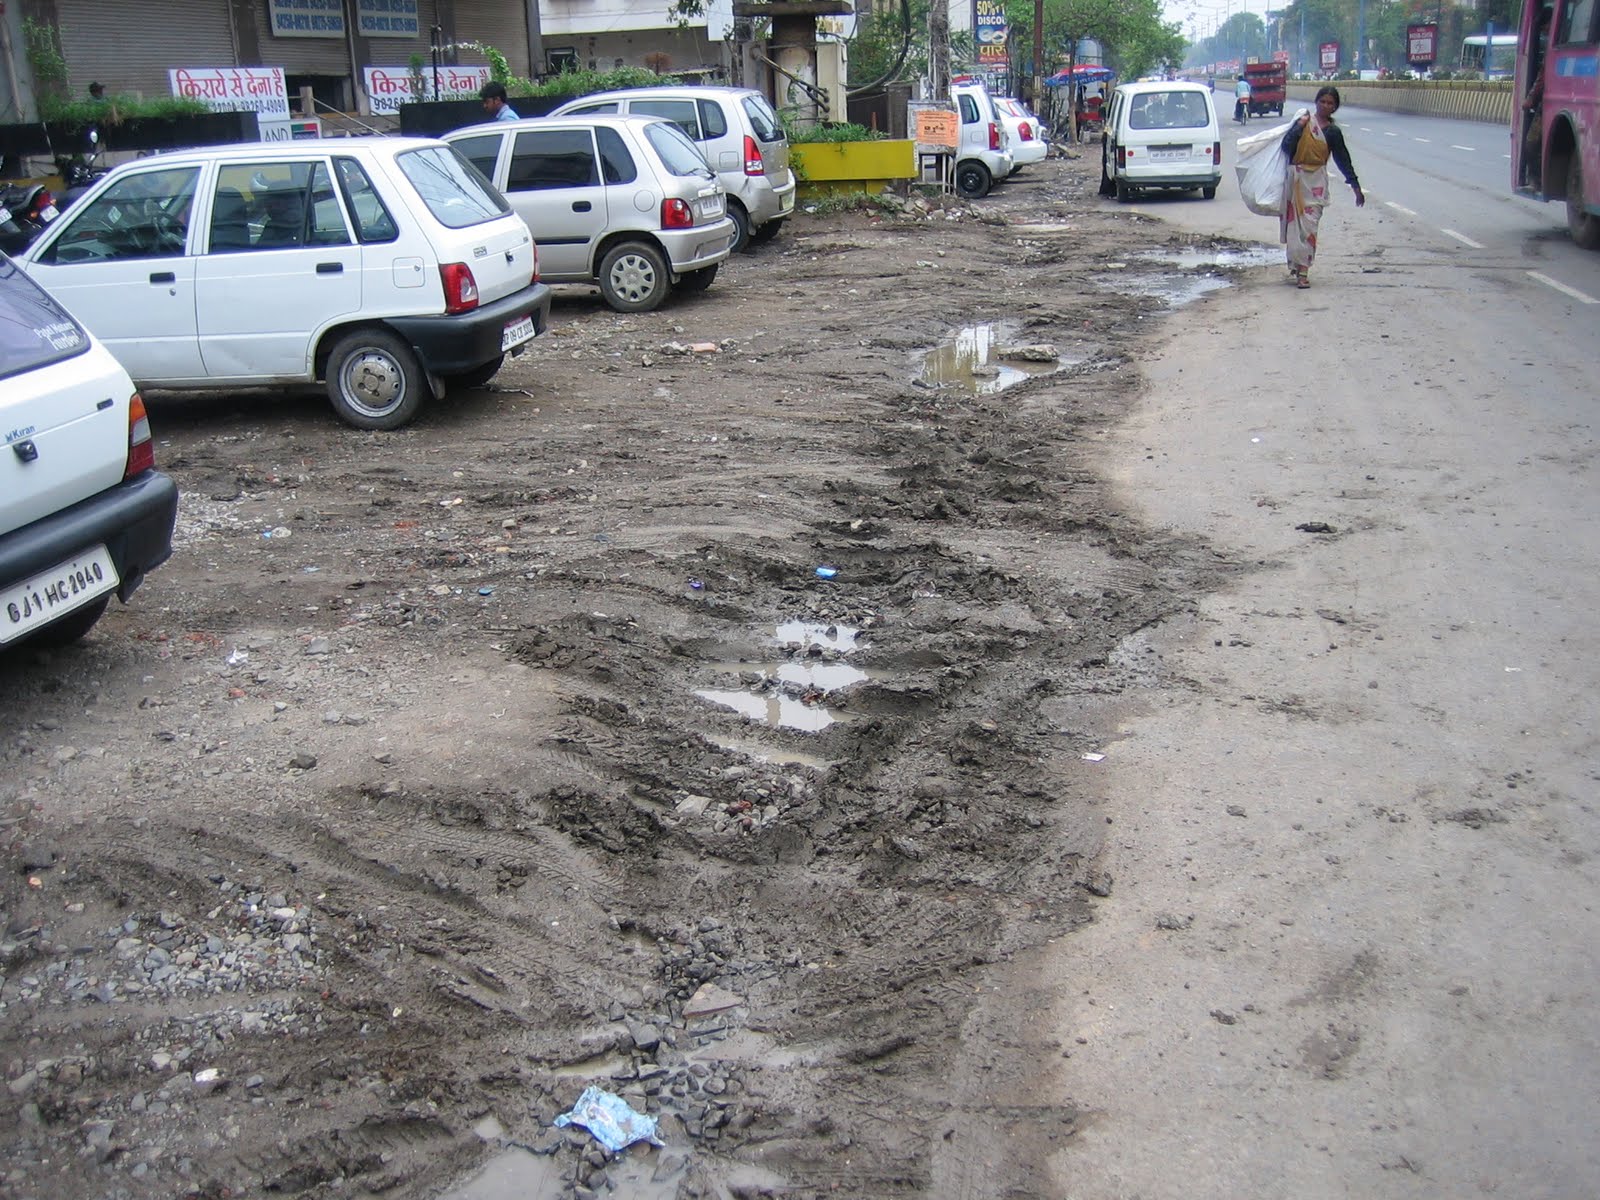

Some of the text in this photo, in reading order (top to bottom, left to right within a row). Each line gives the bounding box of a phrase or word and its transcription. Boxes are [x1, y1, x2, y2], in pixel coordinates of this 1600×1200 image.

[977, 16, 1007, 25] DISCOU
[176, 67, 283, 98] किराये से देना है
[448, 69, 477, 93] देना
